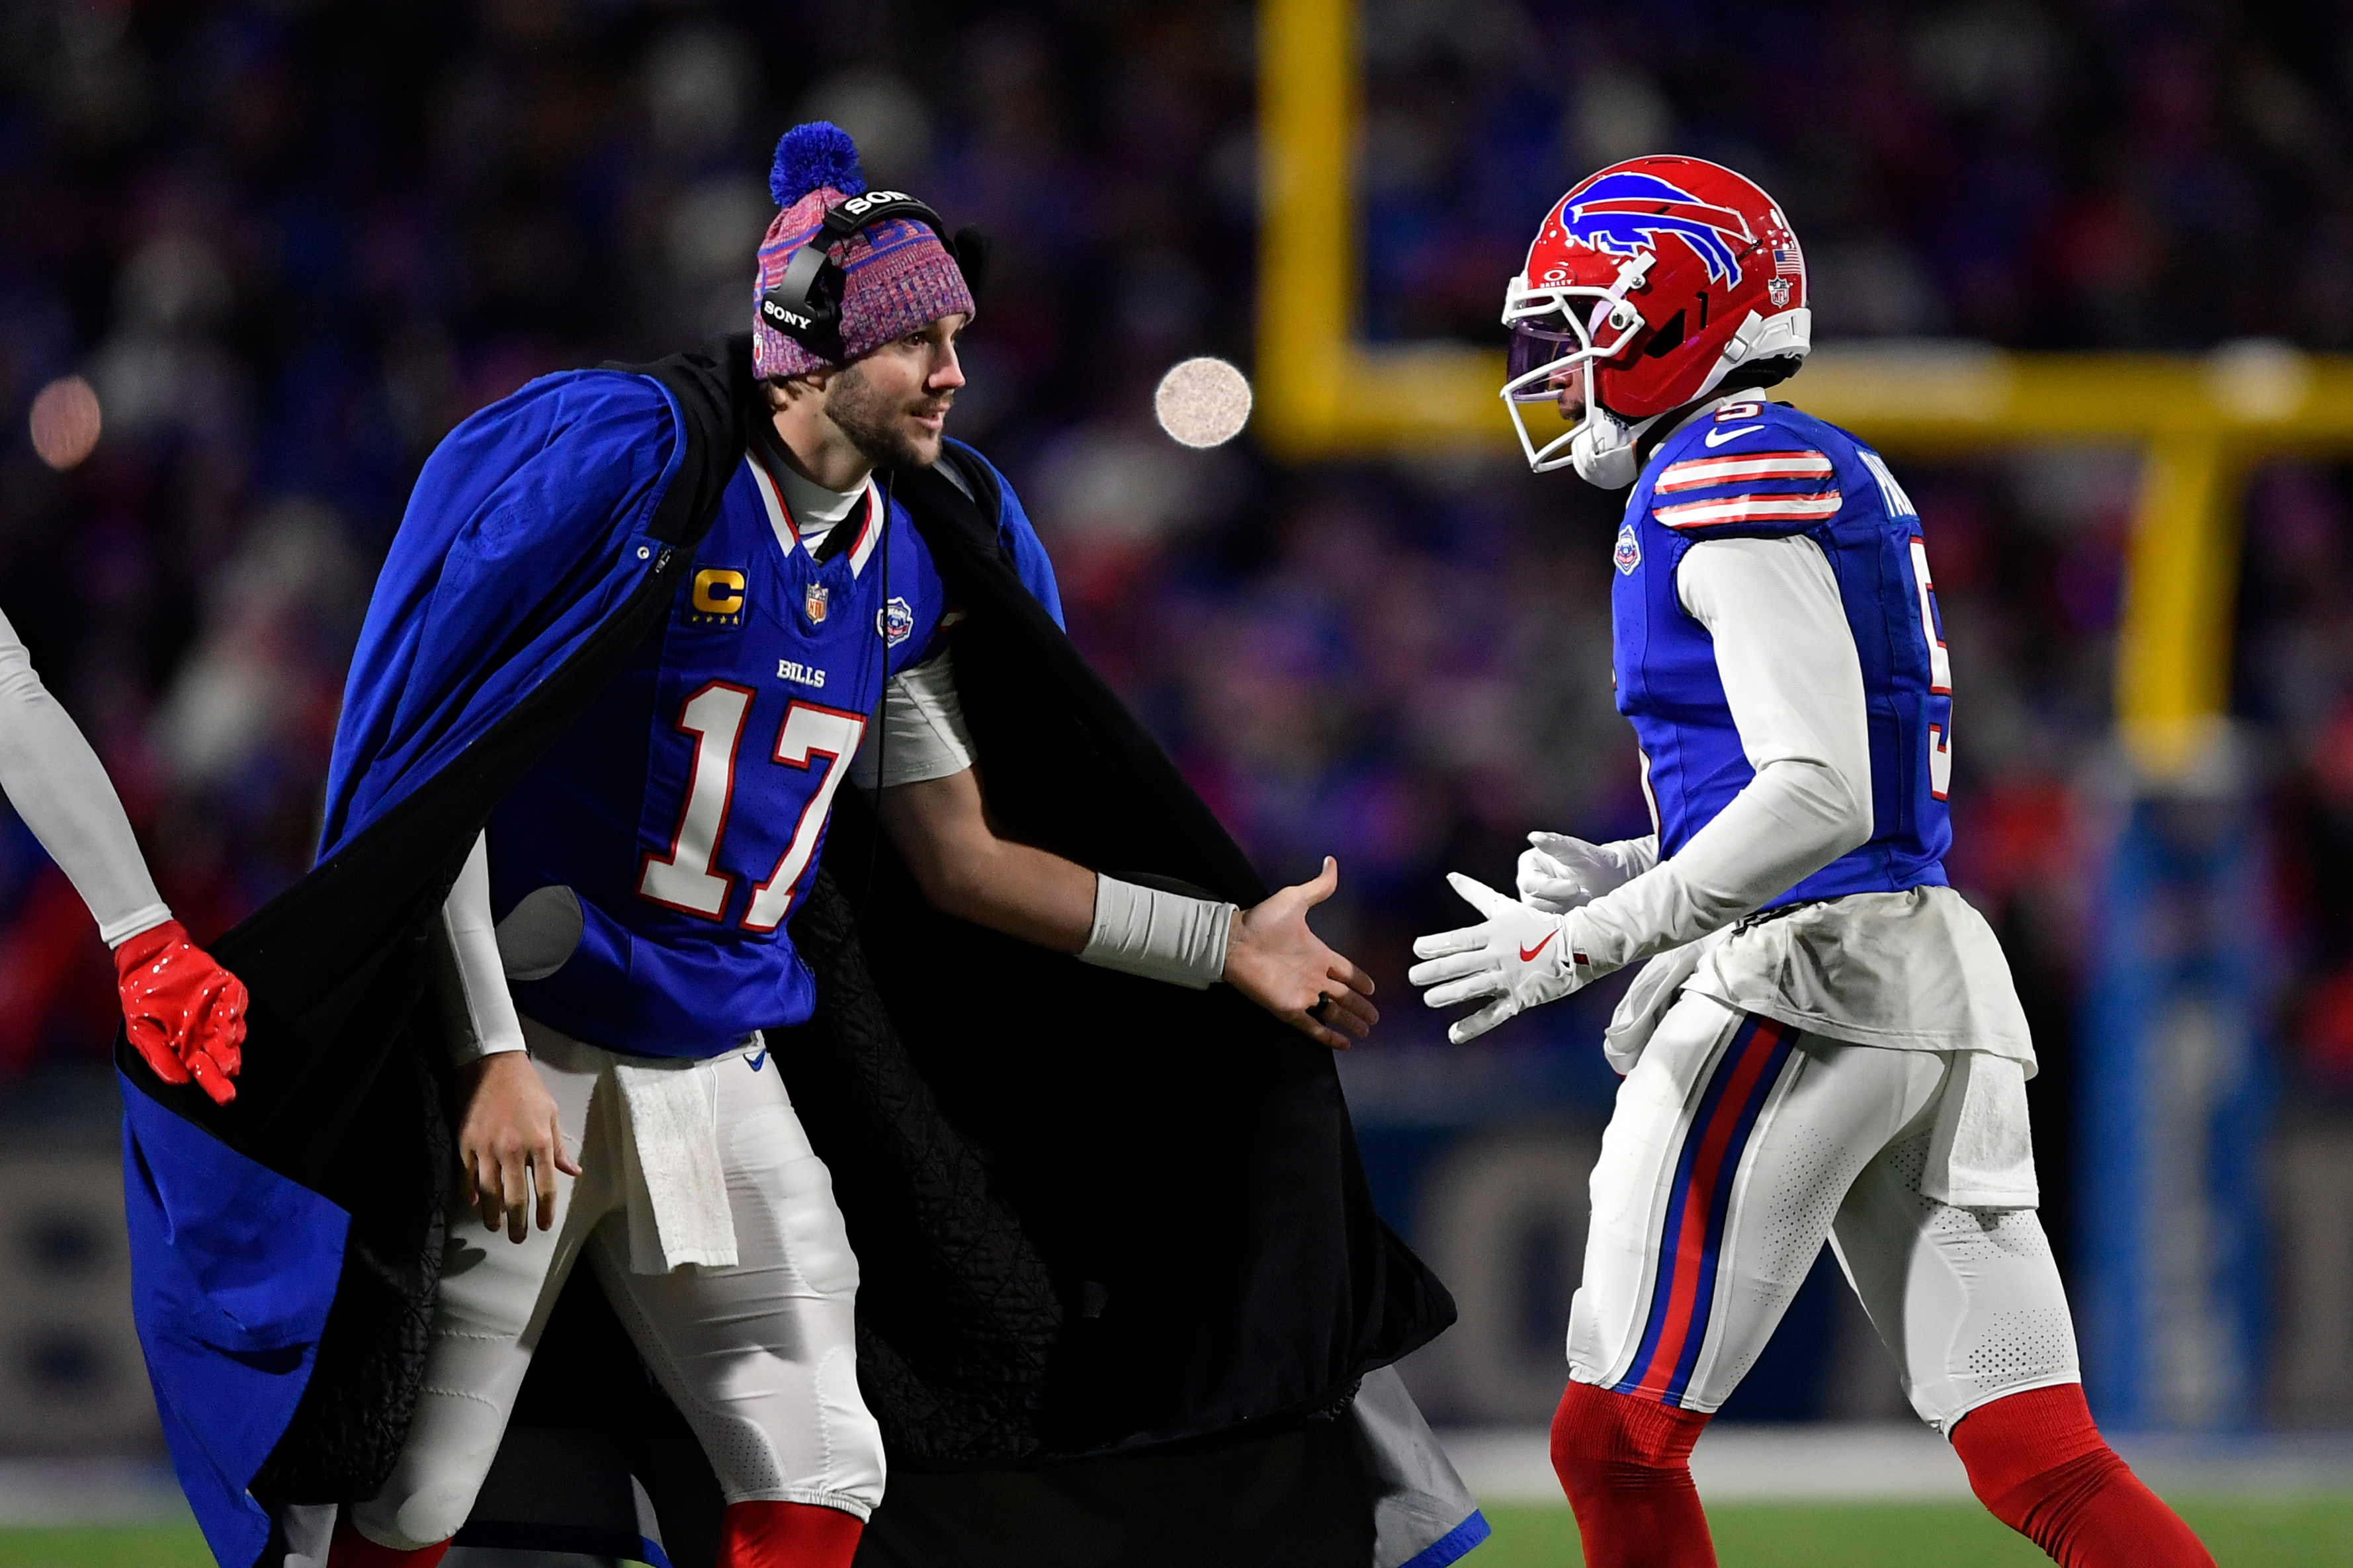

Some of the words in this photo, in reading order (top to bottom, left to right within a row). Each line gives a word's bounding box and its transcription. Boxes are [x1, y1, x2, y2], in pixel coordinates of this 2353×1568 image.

[1540, 279, 1574, 288] OAKLEY
[764, 300, 812, 329] SONY
[1715, 401, 1762, 423] 5
[693, 569, 745, 614] C
[808, 598, 824, 619] NFL
[777, 659, 826, 688] BILLS
[636, 679, 868, 934] 17
